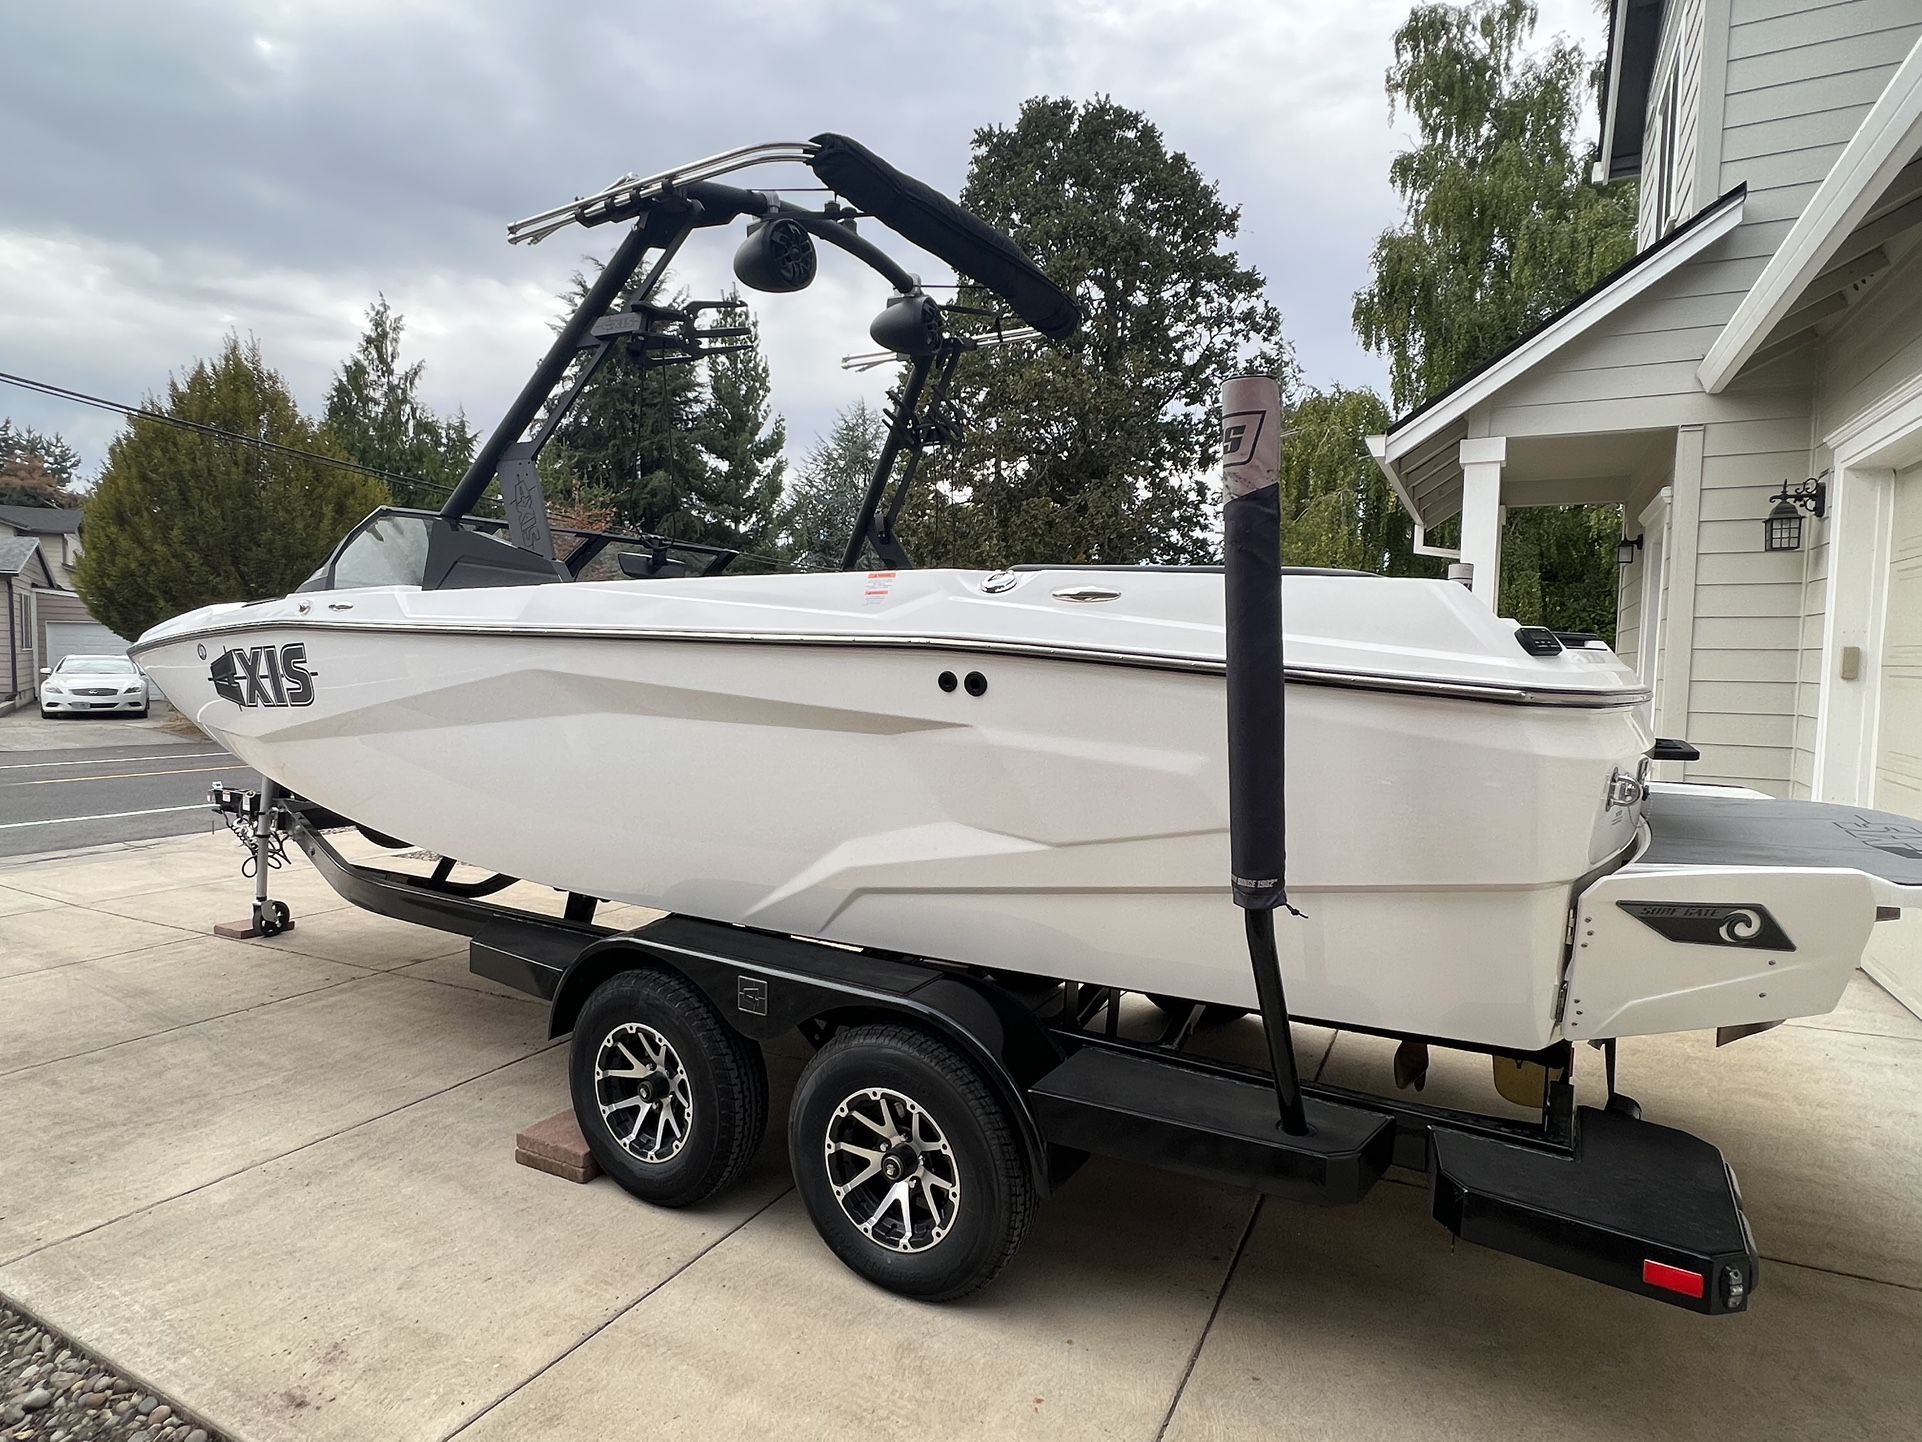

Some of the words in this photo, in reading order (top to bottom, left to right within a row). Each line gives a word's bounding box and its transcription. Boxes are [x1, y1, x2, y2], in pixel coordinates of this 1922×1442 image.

[210, 642, 316, 708] AXIS
[1640, 906, 1680, 917] SURF
[1684, 907, 1720, 918] GATE
